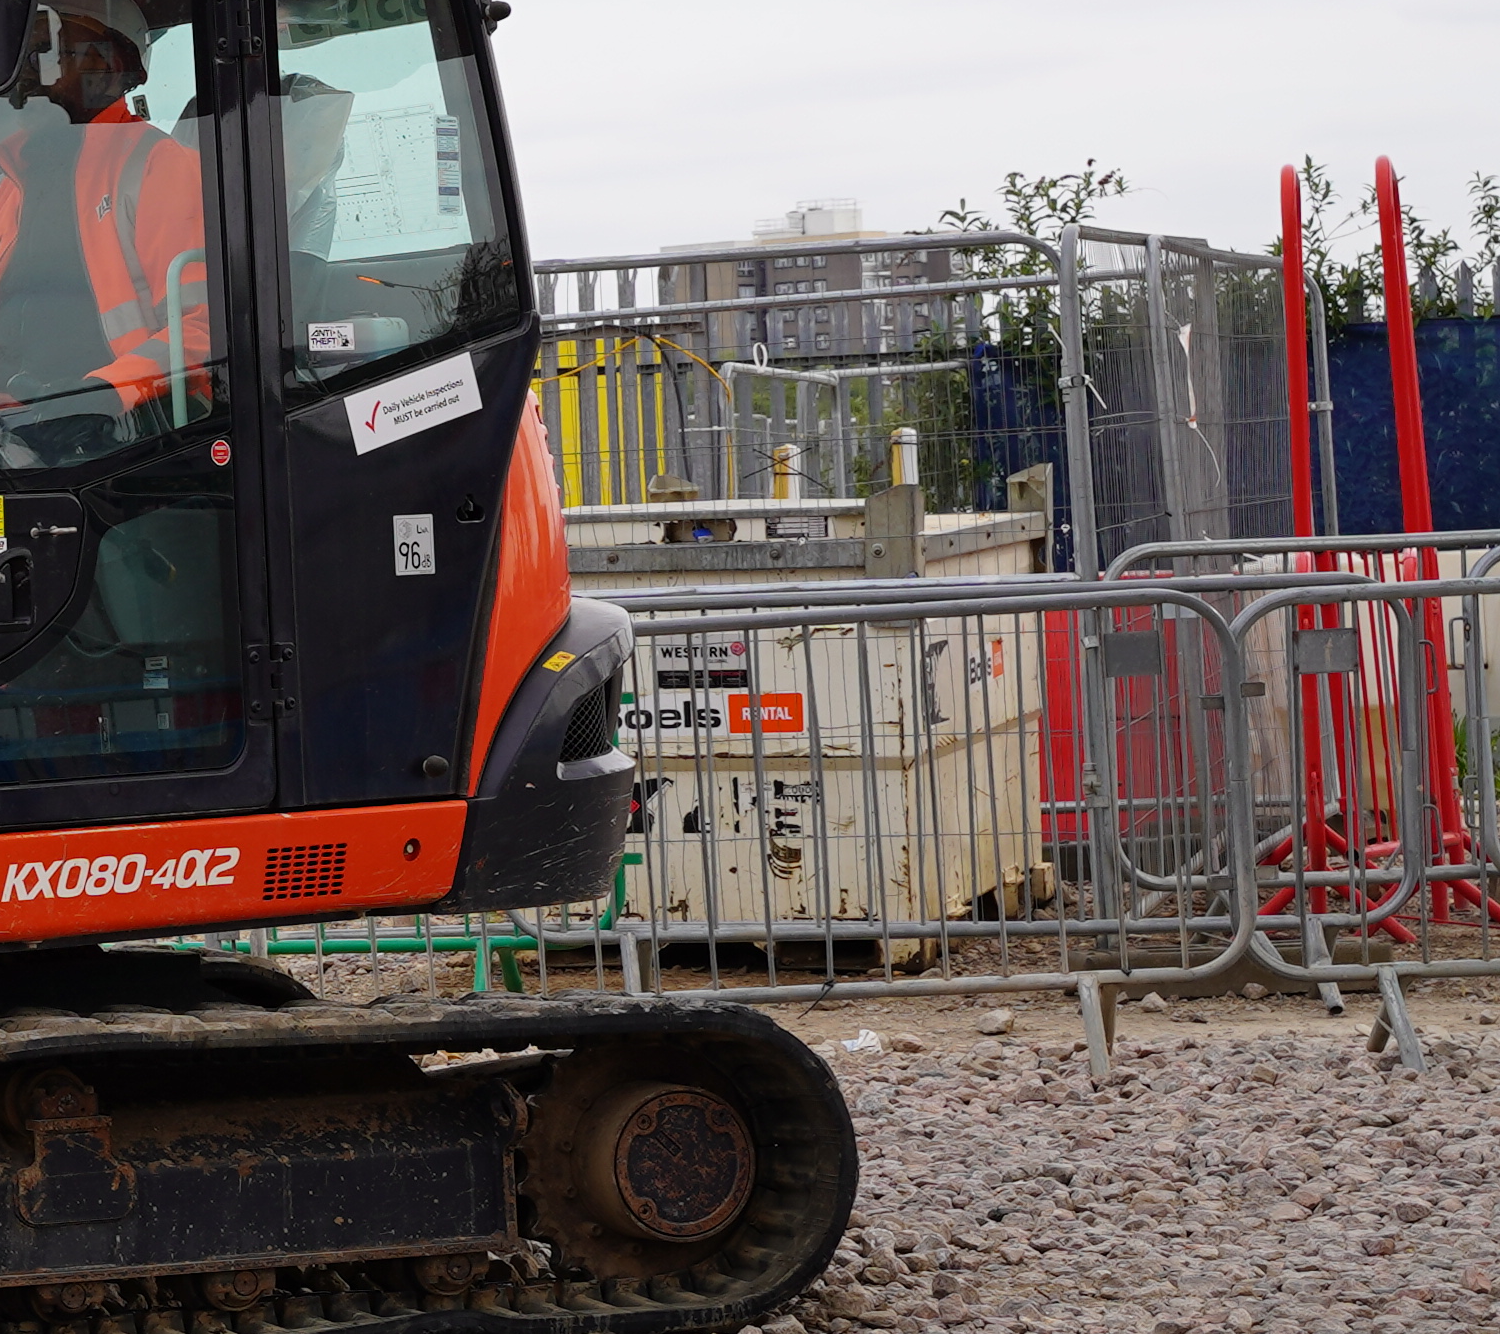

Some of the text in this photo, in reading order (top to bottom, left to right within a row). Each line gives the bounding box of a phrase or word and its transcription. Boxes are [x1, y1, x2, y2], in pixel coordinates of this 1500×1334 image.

[382, 378, 464, 415] Daily Vehicle Inspections
[393, 394, 460, 425] MUST be carried out
[399, 541, 420, 570] 96
[661, 646, 728, 658] WESTRN
[618, 701, 793, 729] oels RNTAL
